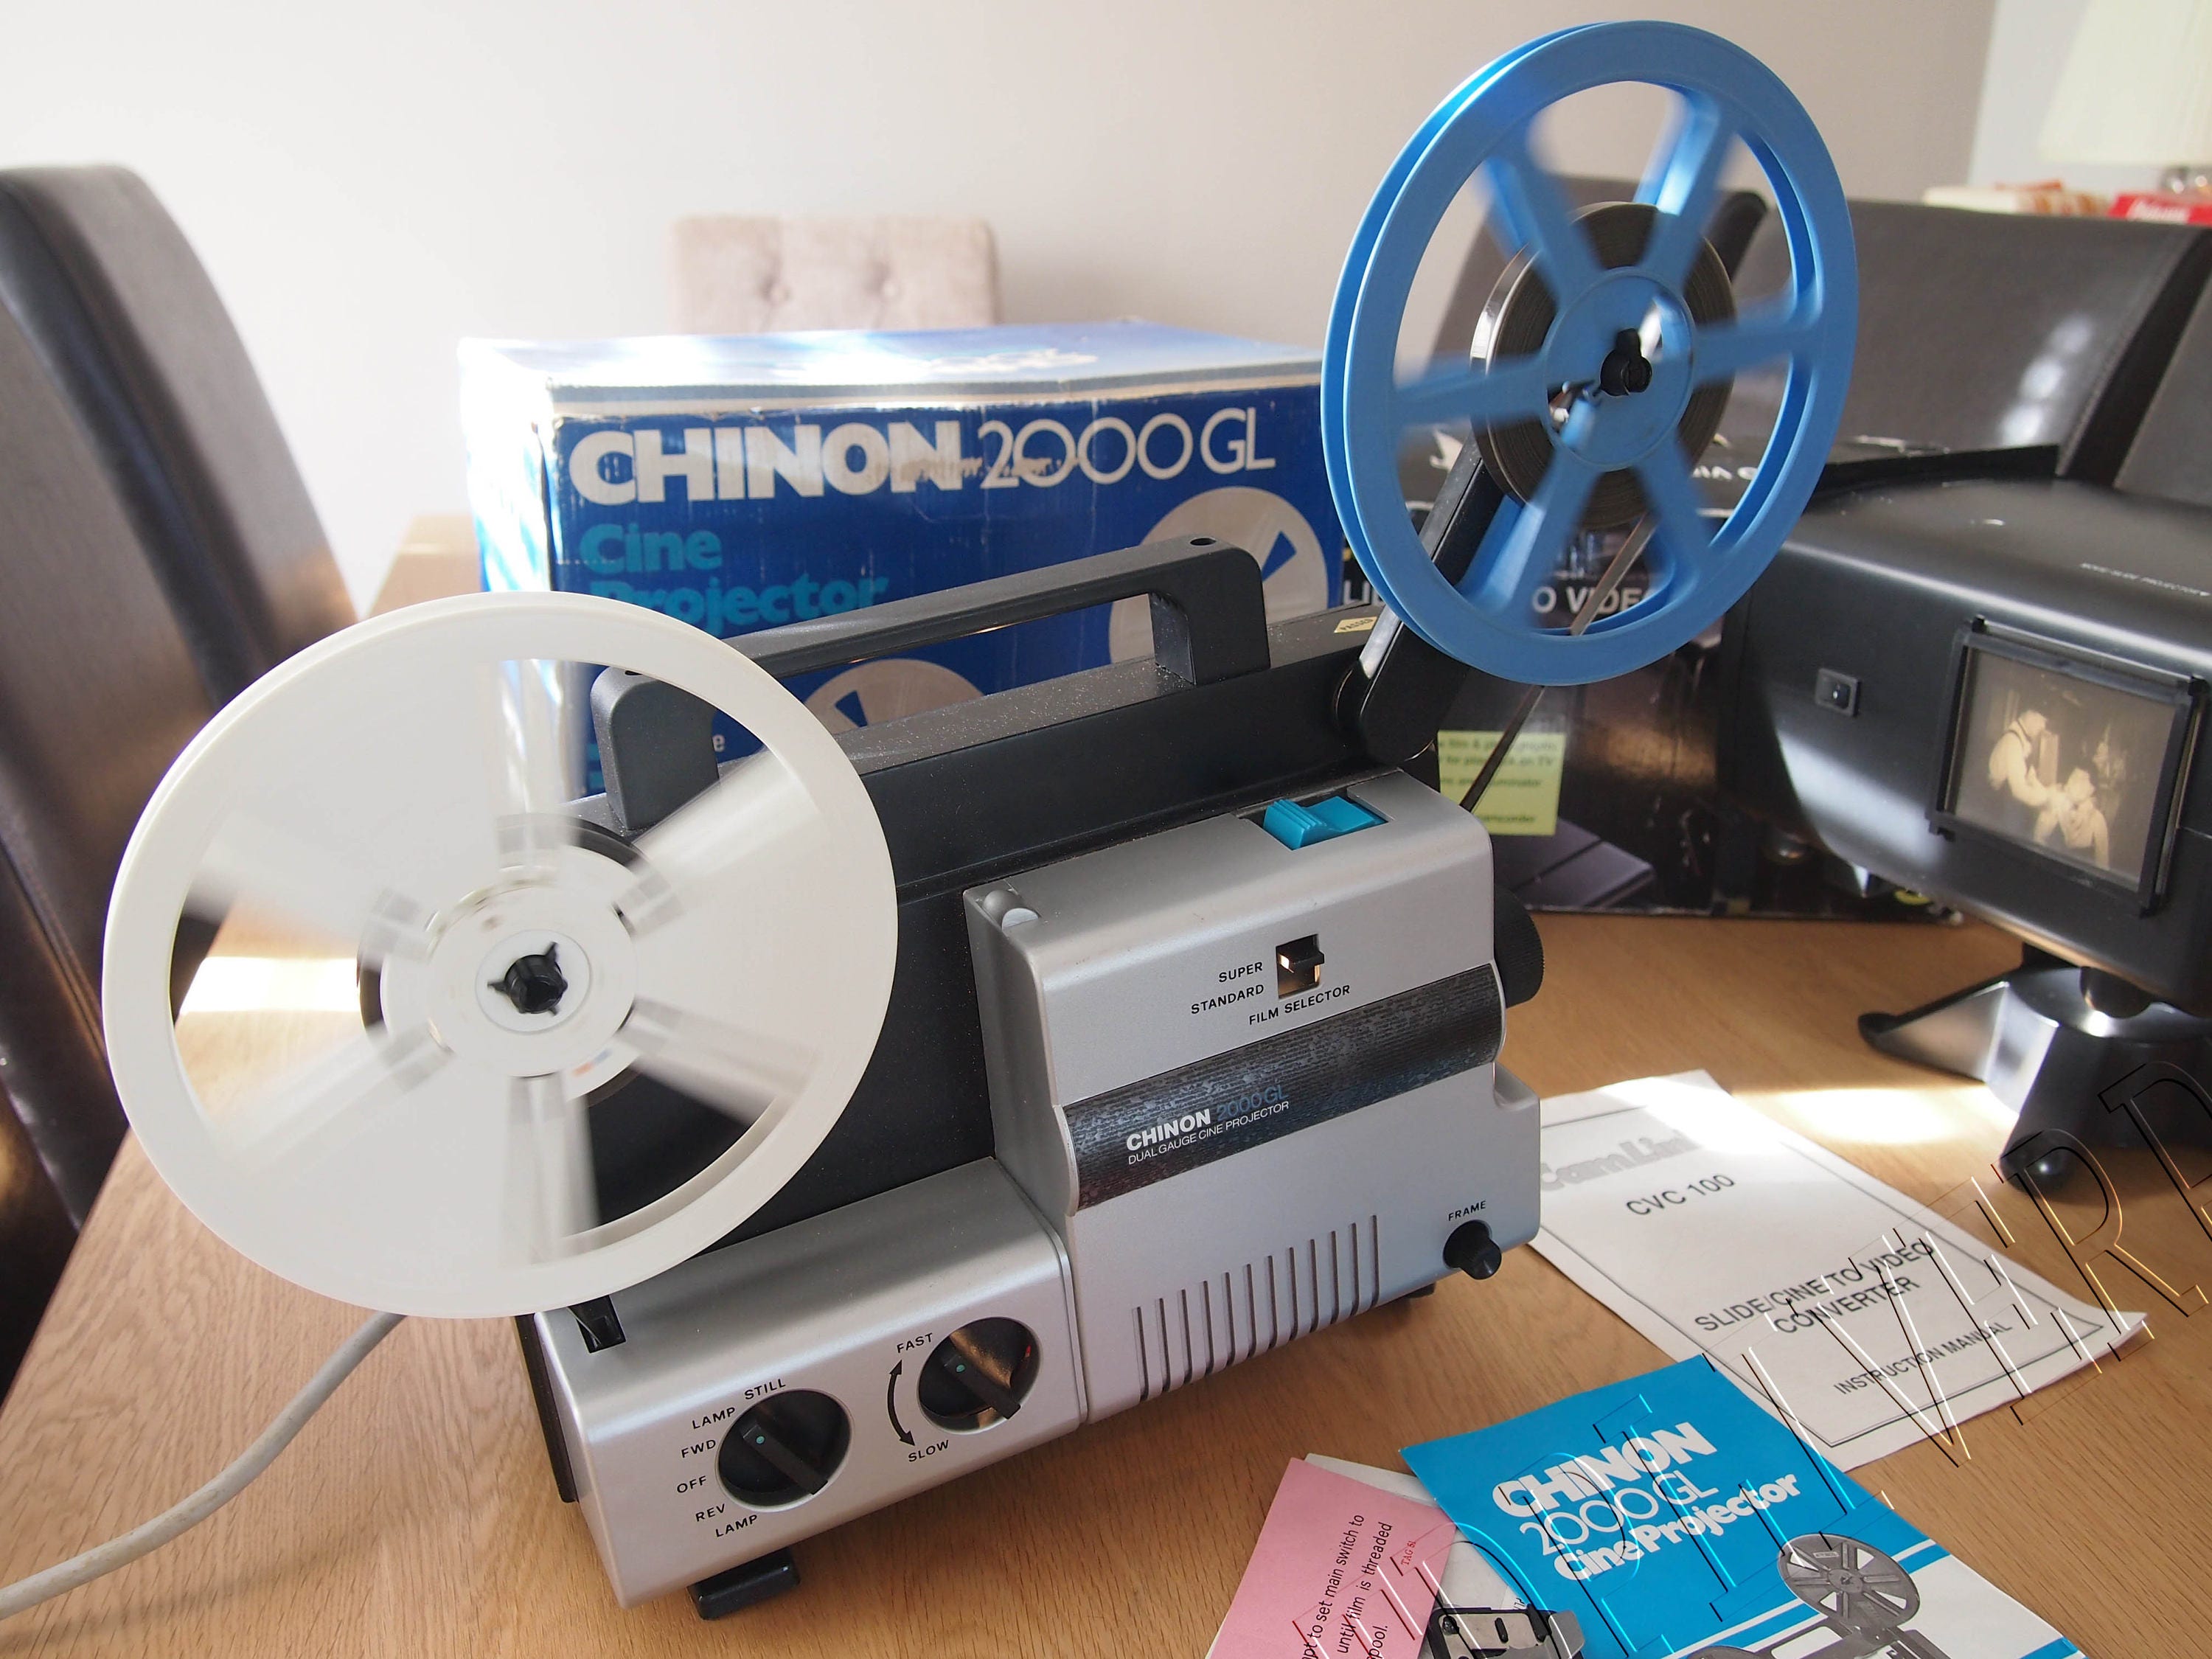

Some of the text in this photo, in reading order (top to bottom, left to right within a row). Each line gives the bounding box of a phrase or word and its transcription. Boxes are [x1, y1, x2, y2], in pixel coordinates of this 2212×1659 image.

[569, 420, 962, 506] CHINON
[580, 524, 723, 574] Cine
[588, 573, 890, 636] Projector
[1219, 961, 1263, 983] SUPER
[1191, 984, 1265, 1015] STANDARD
[1248, 984, 1350, 1026] FILM SELECTOR
[1126, 1108, 1211, 1152] CHINON
[1128, 1101, 1290, 1165] DUAL GAUGE CINE PROJECTOR
[1448, 1200, 1486, 1222] FRAME
[1627, 1174, 1736, 1217] CVC 100
[1824, 1267, 1864, 1287] TO
[1860, 1241, 1935, 1274] VIDEO
[1773, 1276, 1920, 1335] CONVERTER
[897, 1332, 933, 1354] FAST
[1833, 1322, 2014, 1395] INSTRUCTION MANUAL
[692, 1378, 787, 1430] LAMP STILL
[681, 1439, 716, 1458] FWD
[908, 1439, 949, 1462] SLOW
[677, 1475, 707, 1494] OFF
[1492, 1422, 1718, 1519] CHINON
[695, 1503, 726, 1522] REV
[715, 1514, 758, 1537] LAMP
[1307, 1624, 1324, 1639] to
[1316, 1600, 1333, 1622] set
[1325, 1568, 1344, 1598] main
[1336, 1528, 1360, 1566] switch
[1349, 1514, 1365, 1527] to
[1400, 1548, 1414, 1565] TAG
[1337, 1521, 1394, 1654] until film is threaded
